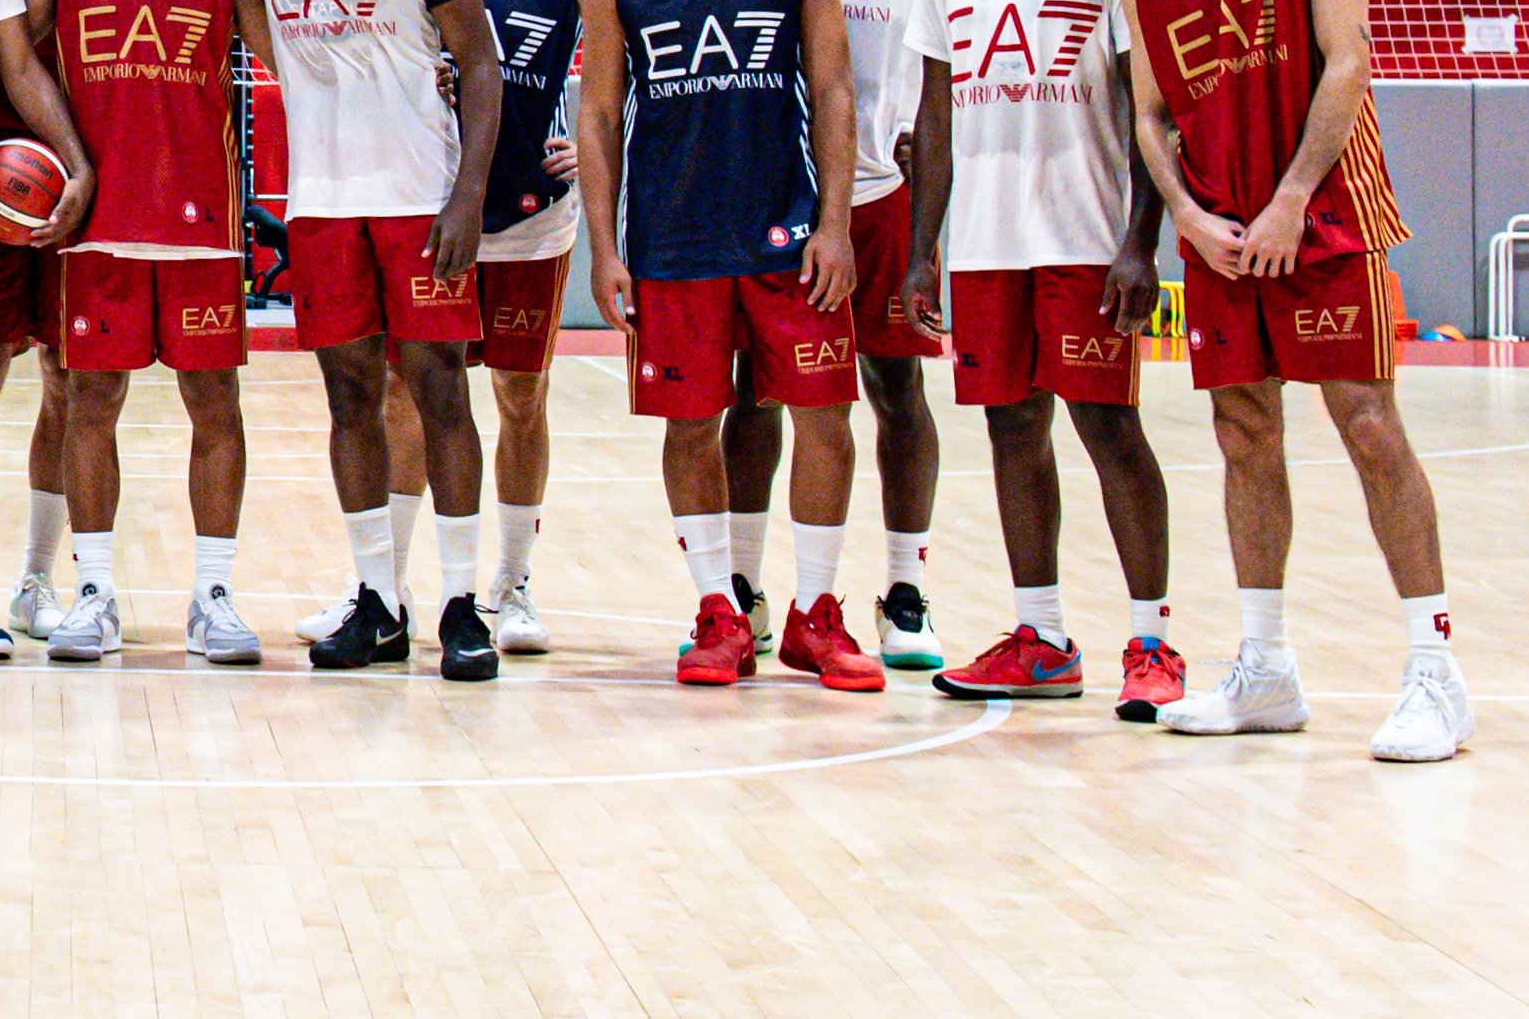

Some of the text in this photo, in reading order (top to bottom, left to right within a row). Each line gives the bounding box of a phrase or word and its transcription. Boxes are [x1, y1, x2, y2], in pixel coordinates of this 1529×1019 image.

[843, 5, 890, 23] RMANI
[78, 5, 213, 64] EA7
[640, 11, 786, 80] EA7
[947, 0, 1103, 84] EA7
[82, 63, 142, 82] EMPORIO
[648, 73, 784, 99] EMPORIO ARMANI
[1025, 83, 1093, 105] ARMANI
[1319, 212, 1343, 225] XL
[411, 274, 469, 299] EA7
[182, 305, 236, 329] EA7
[1295, 306, 1360, 334] EA7
[794, 337, 850, 368] EA7
[1062, 334, 1123, 360] EA7
